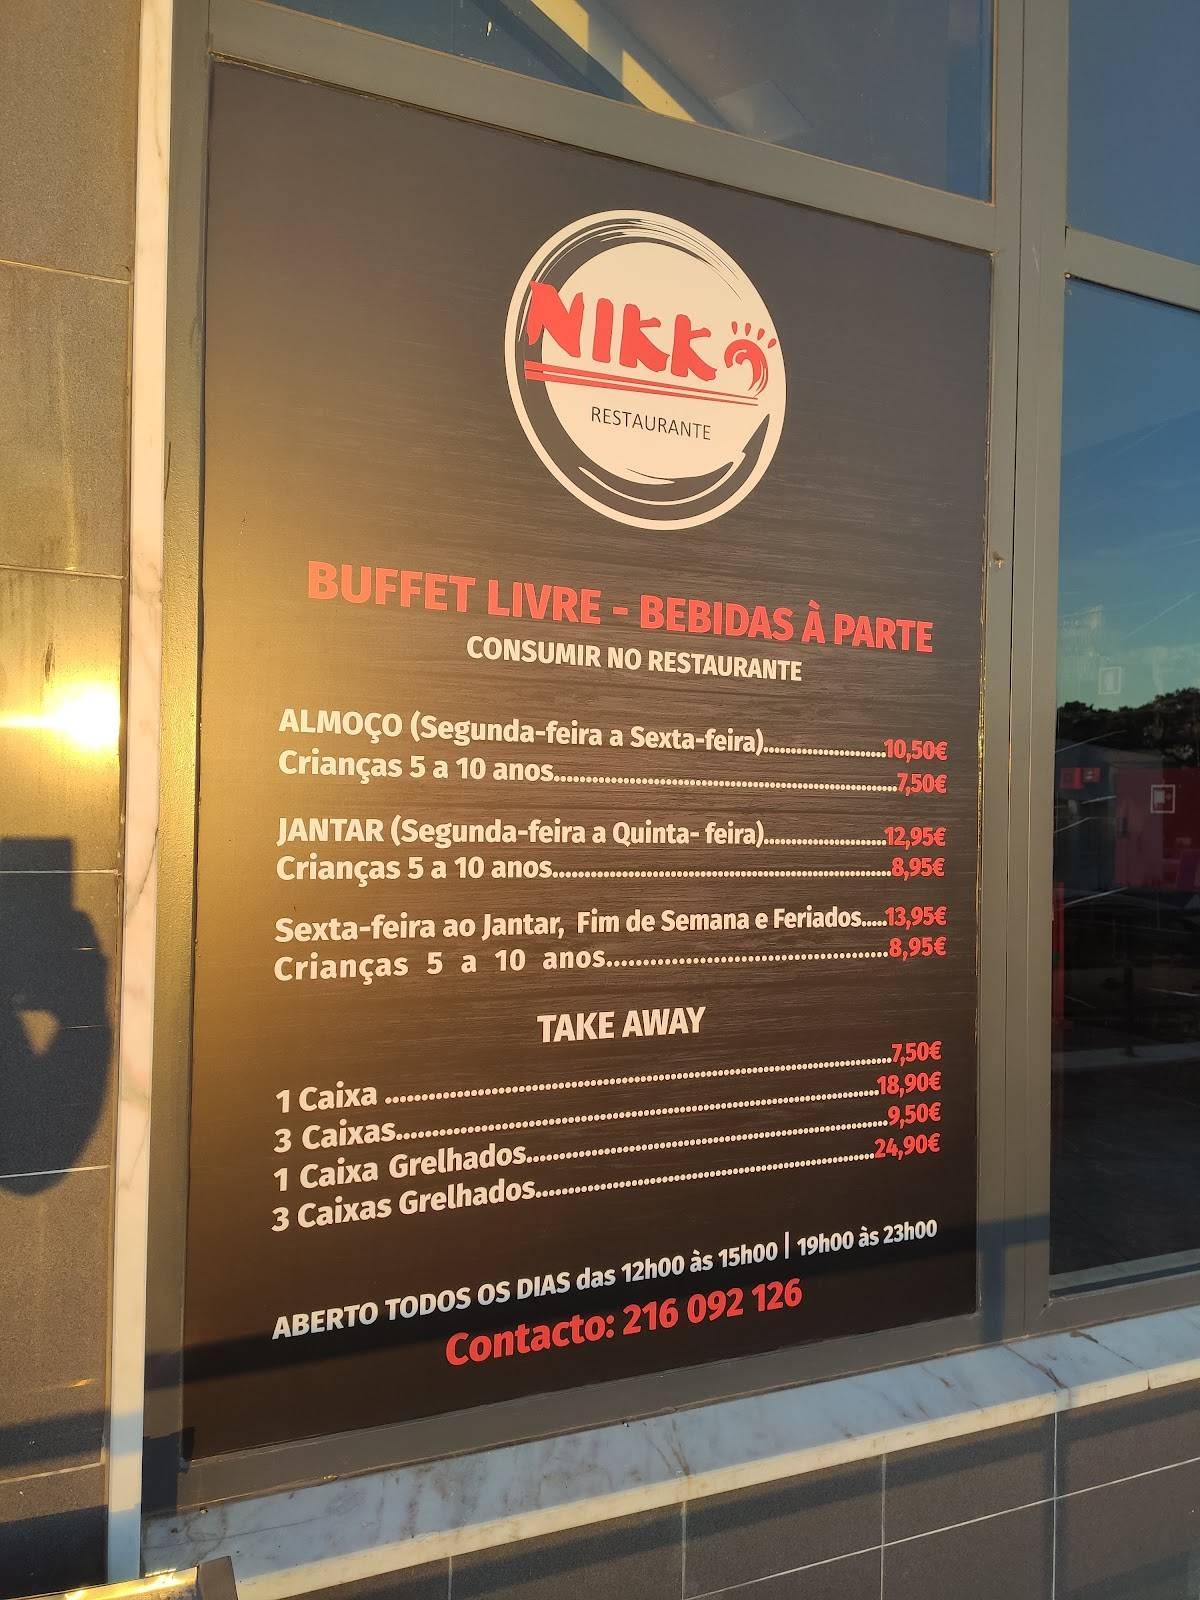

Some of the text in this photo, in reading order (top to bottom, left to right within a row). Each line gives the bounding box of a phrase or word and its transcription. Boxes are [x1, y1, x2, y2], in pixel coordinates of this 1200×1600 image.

[591, 406, 711, 441] RESTAURANTE
[308, 560, 476, 613] BUFFET
[487, 579, 602, 625] LIVRE
[640, 594, 794, 641] BEBIDAS
[801, 600, 826, 643] À
[833, 613, 934, 653] PARTE
[466, 635, 803, 682] CONSUMIR NO RESTAURANTE
[278, 708, 948, 763] ALMOÇO (Segunda-feira a Sexta-feira) 10,50€
[278, 747, 947, 797] Crianças 5 a 10 anos 7,50€
[276, 817, 384, 846] JANTAR
[391, 814, 586, 849] (Segunda-feira
[592, 827, 606, 844] a
[705, 820, 764, 848] feira)
[884, 827, 946, 850] 12,95€
[276, 852, 945, 888] Crianças 5 a 10 anos 8,95€
[274, 905, 947, 943] Sexta-feira ao Jantar, Fim de Semana e Feriados 13,95€
[274, 936, 946, 985] Crianças 5 a 10 anos 8,95€
[537, 1006, 706, 1043] TAKE AWAY
[275, 1040, 942, 1113] 1 Caixa 7,50€
[274, 1071, 942, 1153] 3 Caixas 18,90€
[274, 1102, 941, 1191] 1 Caixa Grelhados 9,50€
[271, 1133, 941, 1232] 3 Caixas Grelhados 24,90€
[272, 1302, 378, 1340] ABERTO
[385, 1287, 471, 1321] TODOS
[477, 1281, 510, 1305] OS
[517, 1272, 570, 1300] DIAS
[576, 1267, 616, 1291] das
[621, 1255, 685, 1282] 12h00
[690, 1250, 713, 1273] às
[718, 1242, 778, 1268] 15h00
[797, 1231, 854, 1256] 19h00
[858, 1226, 879, 1247] às
[883, 1219, 937, 1244] 23h00
[445, 1278, 802, 1366] Contacto: 216 092 126
